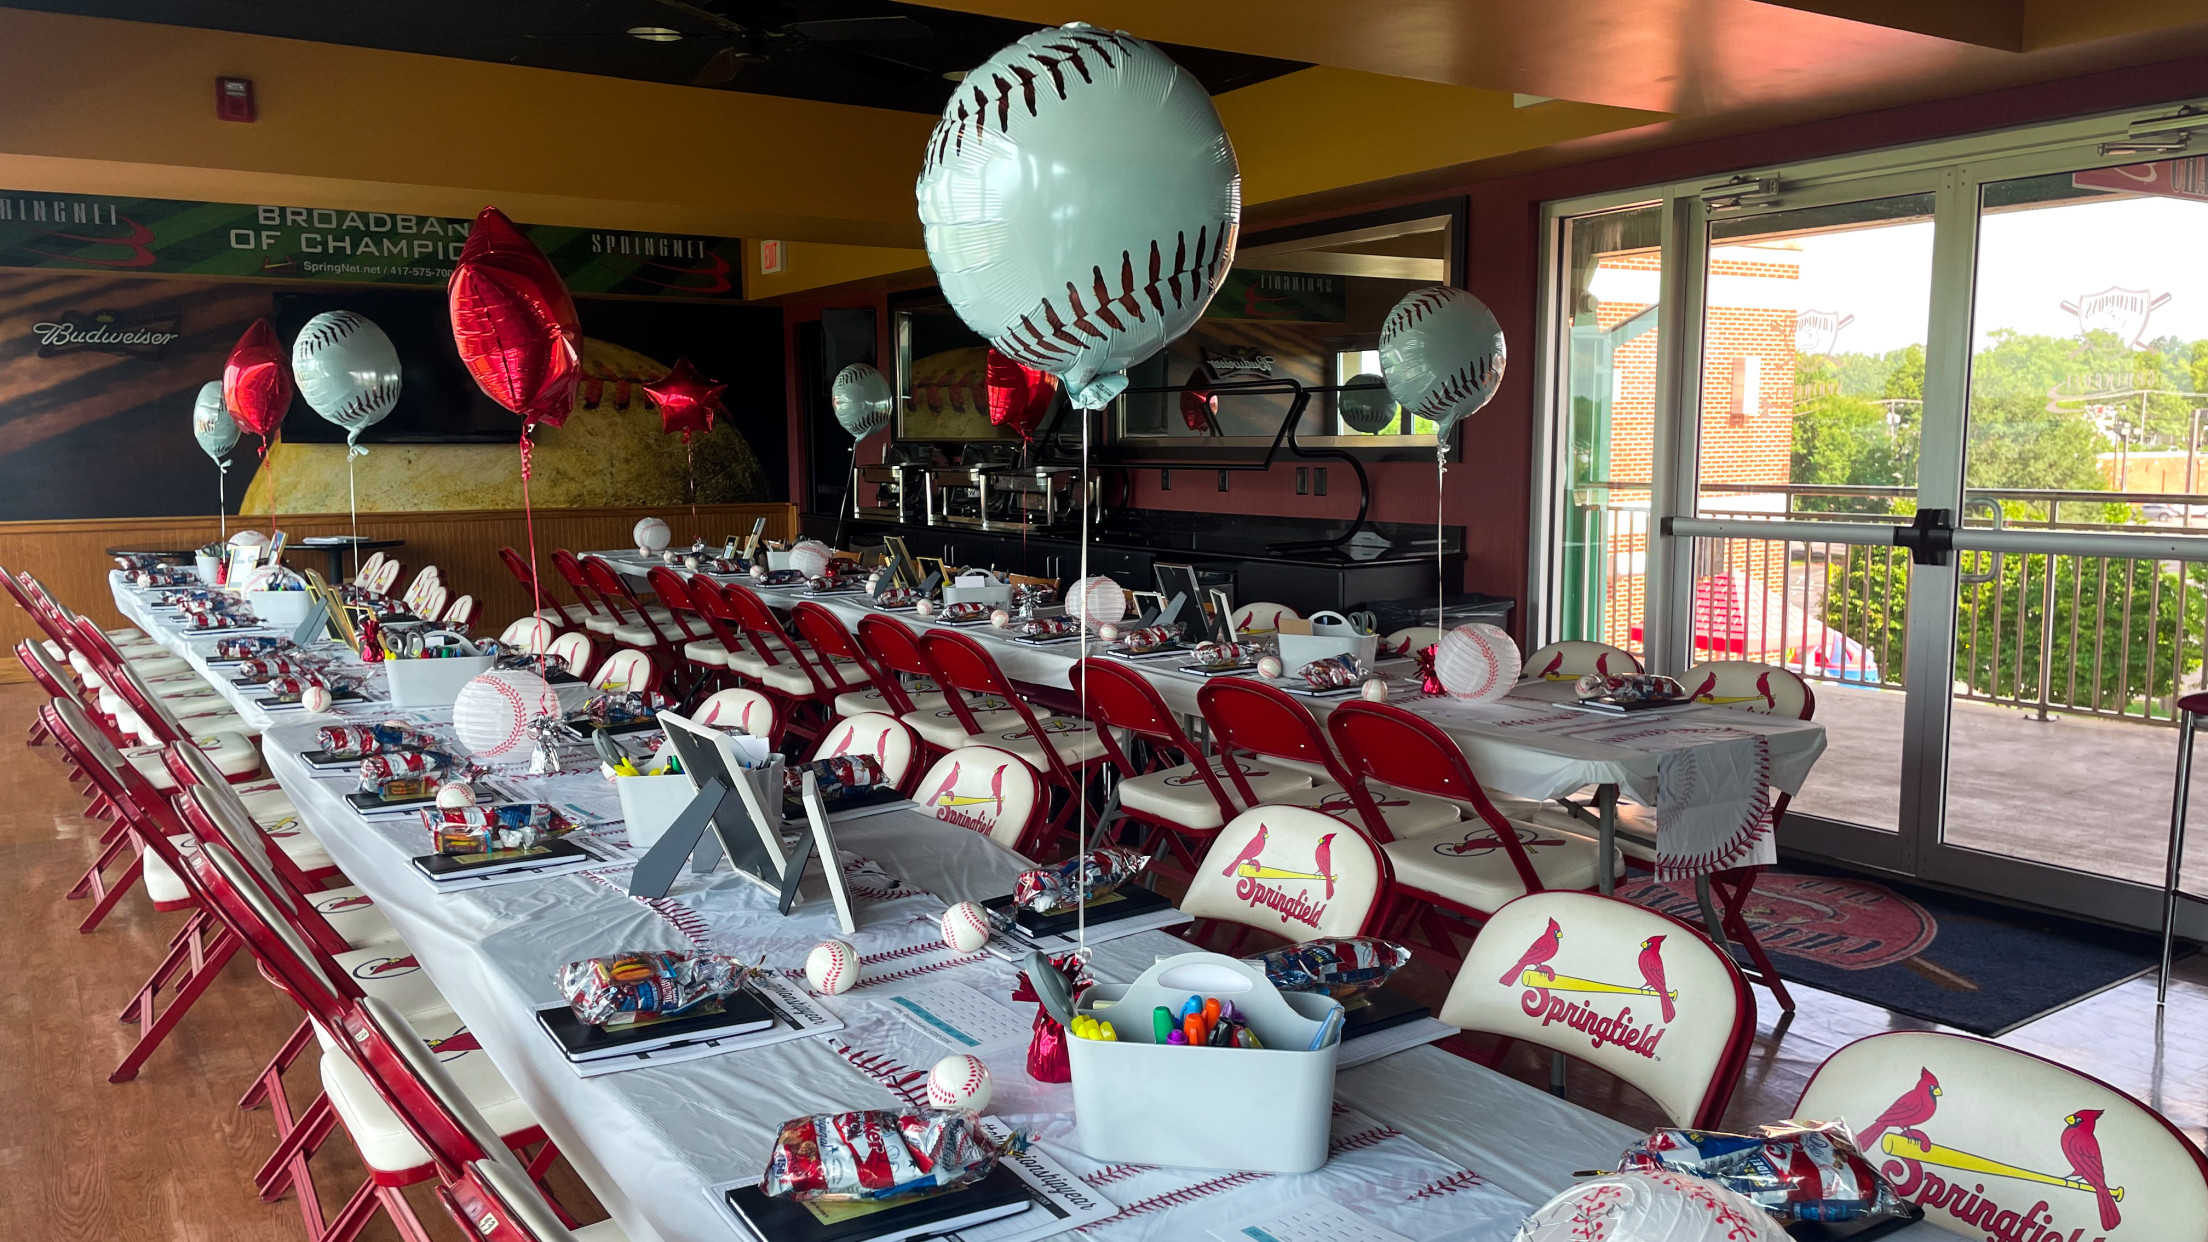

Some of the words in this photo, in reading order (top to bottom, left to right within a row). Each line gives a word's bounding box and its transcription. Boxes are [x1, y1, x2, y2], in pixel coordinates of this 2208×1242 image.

[230, 229, 281, 250] OF
[591, 233, 705, 259] SPRINGNET
[303, 260, 381, 275] SpringNet.net
[33, 321, 178, 346] Budweiser
[1236, 875, 1326, 929] Springfield
[1521, 985, 1669, 1059] Springfield
[1881, 1156, 2107, 1242] Springfiel
